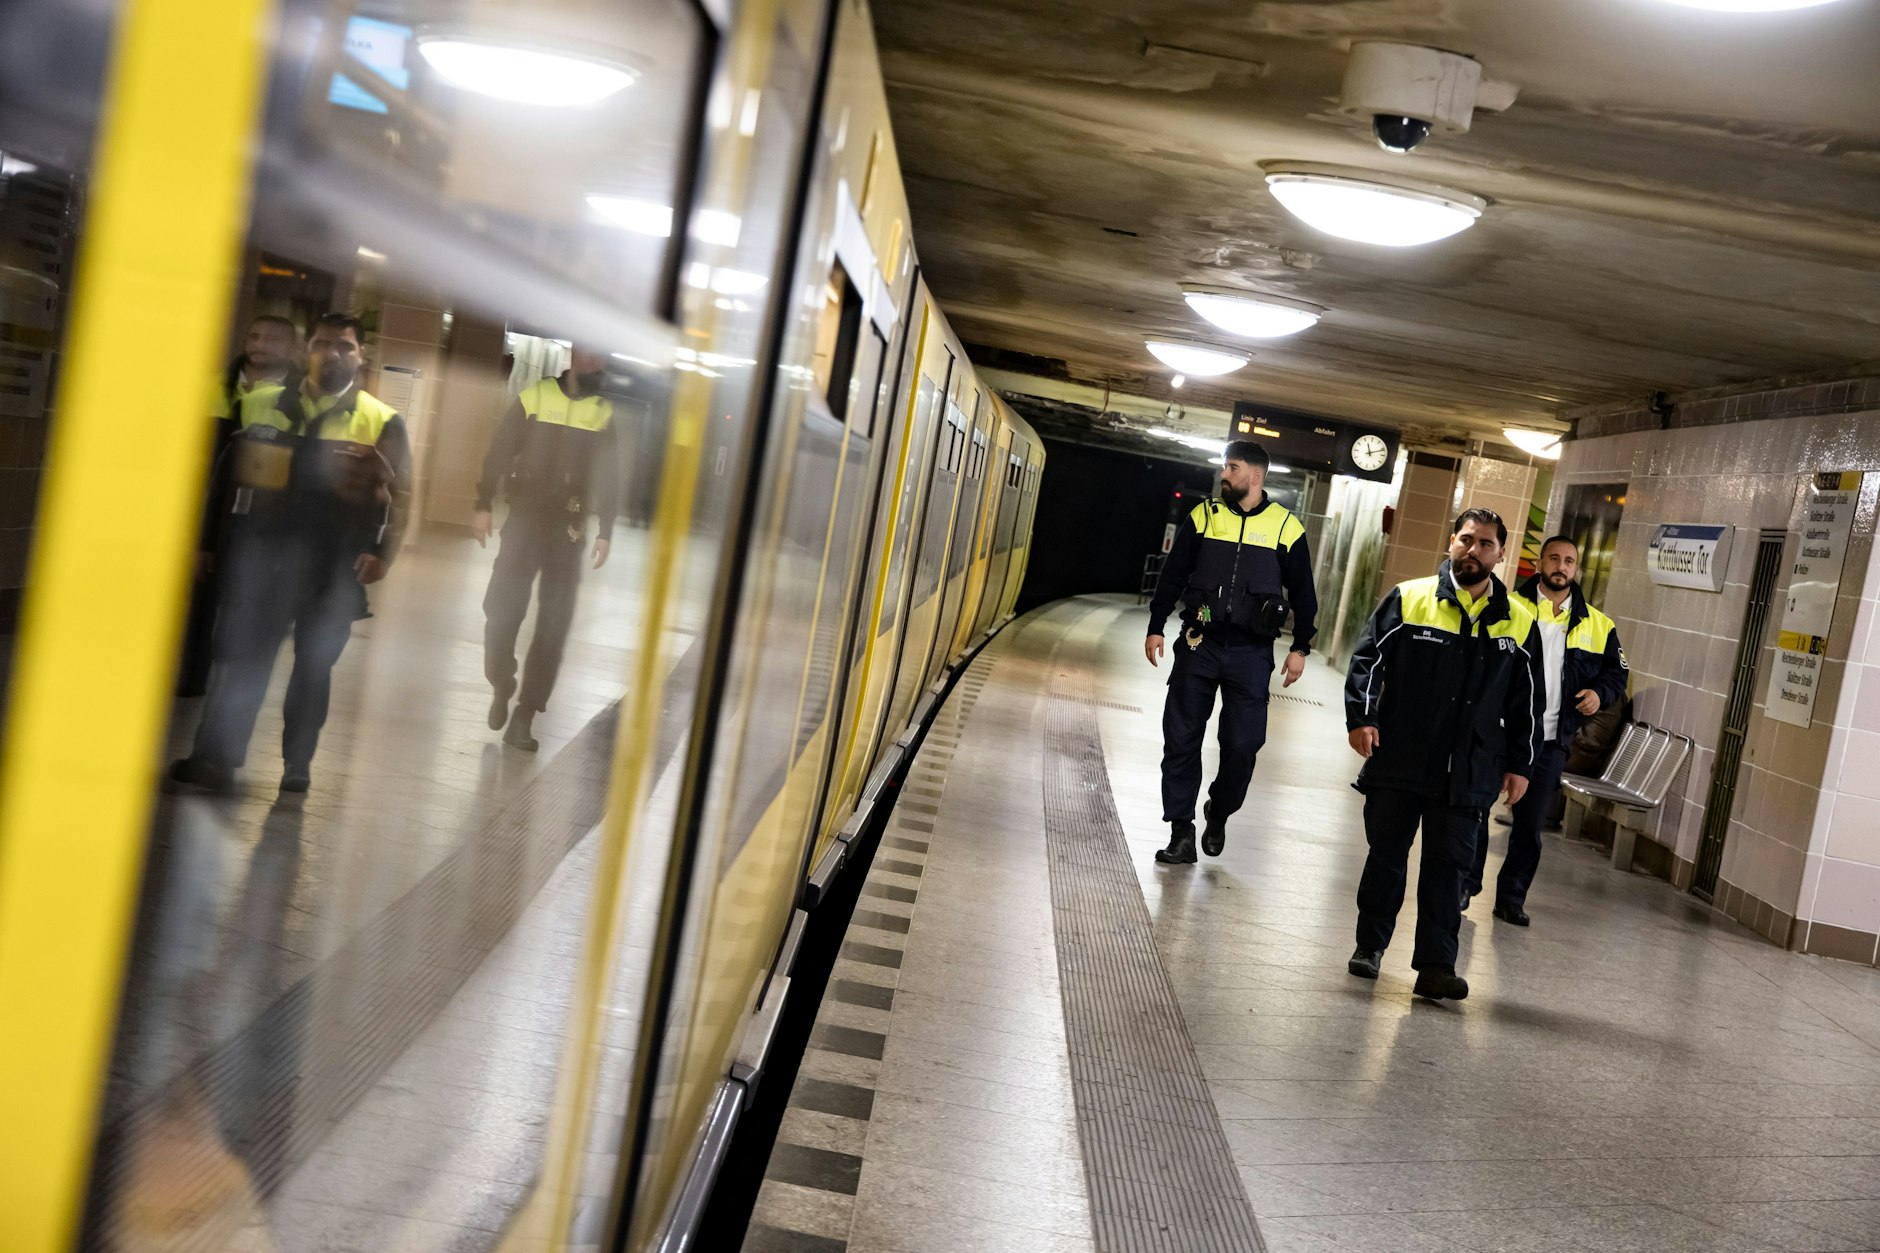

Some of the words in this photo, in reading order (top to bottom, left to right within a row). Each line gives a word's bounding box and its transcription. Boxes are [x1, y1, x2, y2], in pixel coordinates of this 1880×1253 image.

[1241, 414, 1254, 422] Linie
[1256, 416, 1268, 424] Ziel
[1313, 427, 1336, 436] Abfahrt
[1248, 532, 1268, 544] BVG
[1657, 540, 1697, 574] Kottbusser
[1697, 544, 1710, 576] Tor
[1498, 638, 1516, 654] BVG
[1805, 656, 1817, 669] Straße
[1801, 674, 1813, 687] Straße
[1797, 692, 1809, 705] Straße
